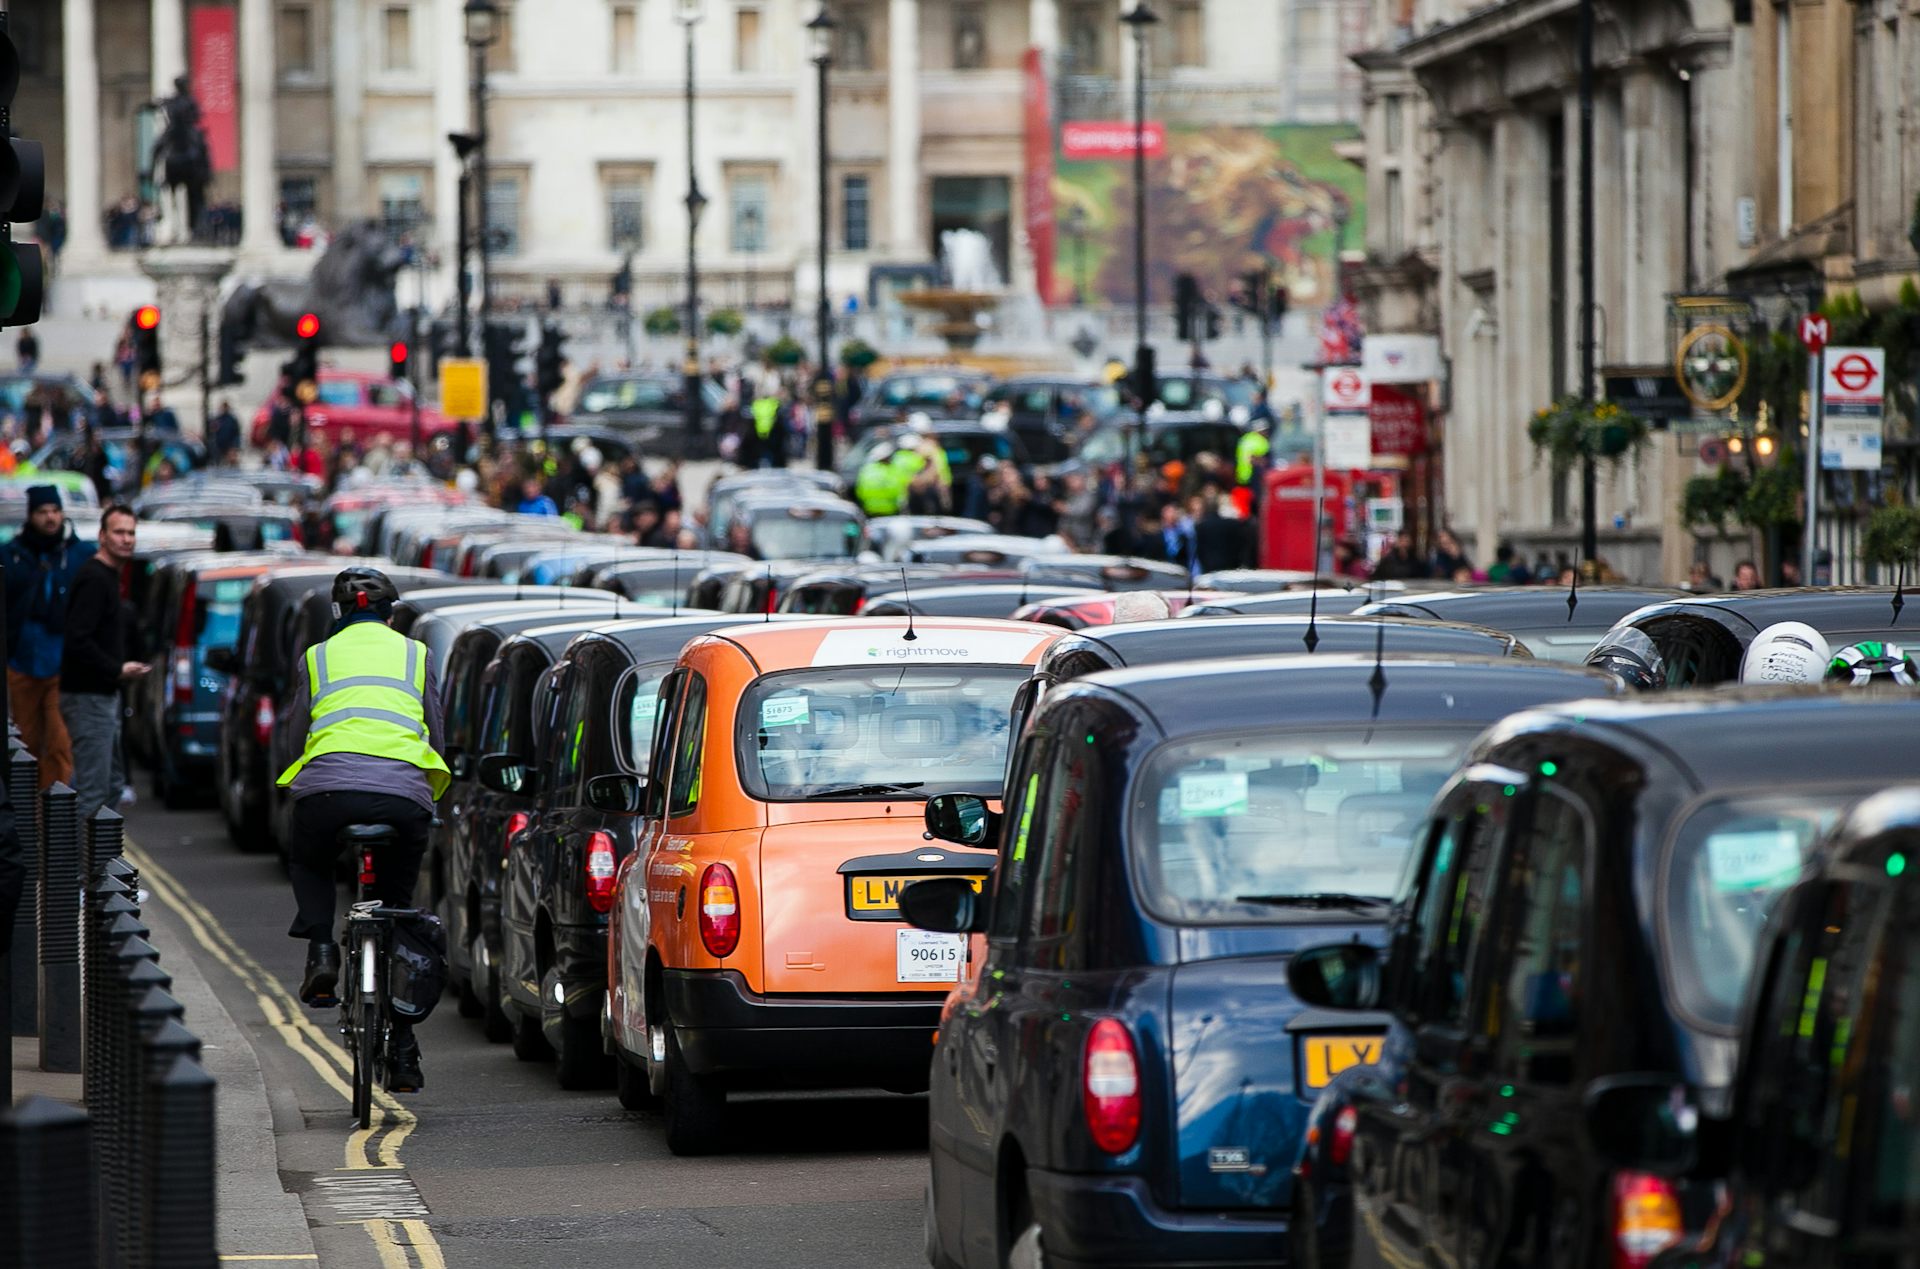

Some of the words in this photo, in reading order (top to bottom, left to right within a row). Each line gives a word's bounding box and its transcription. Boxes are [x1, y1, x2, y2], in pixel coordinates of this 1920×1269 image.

[1803, 319, 1828, 345] M
[886, 646, 969, 659] rightmove
[911, 948, 956, 961] 90615
